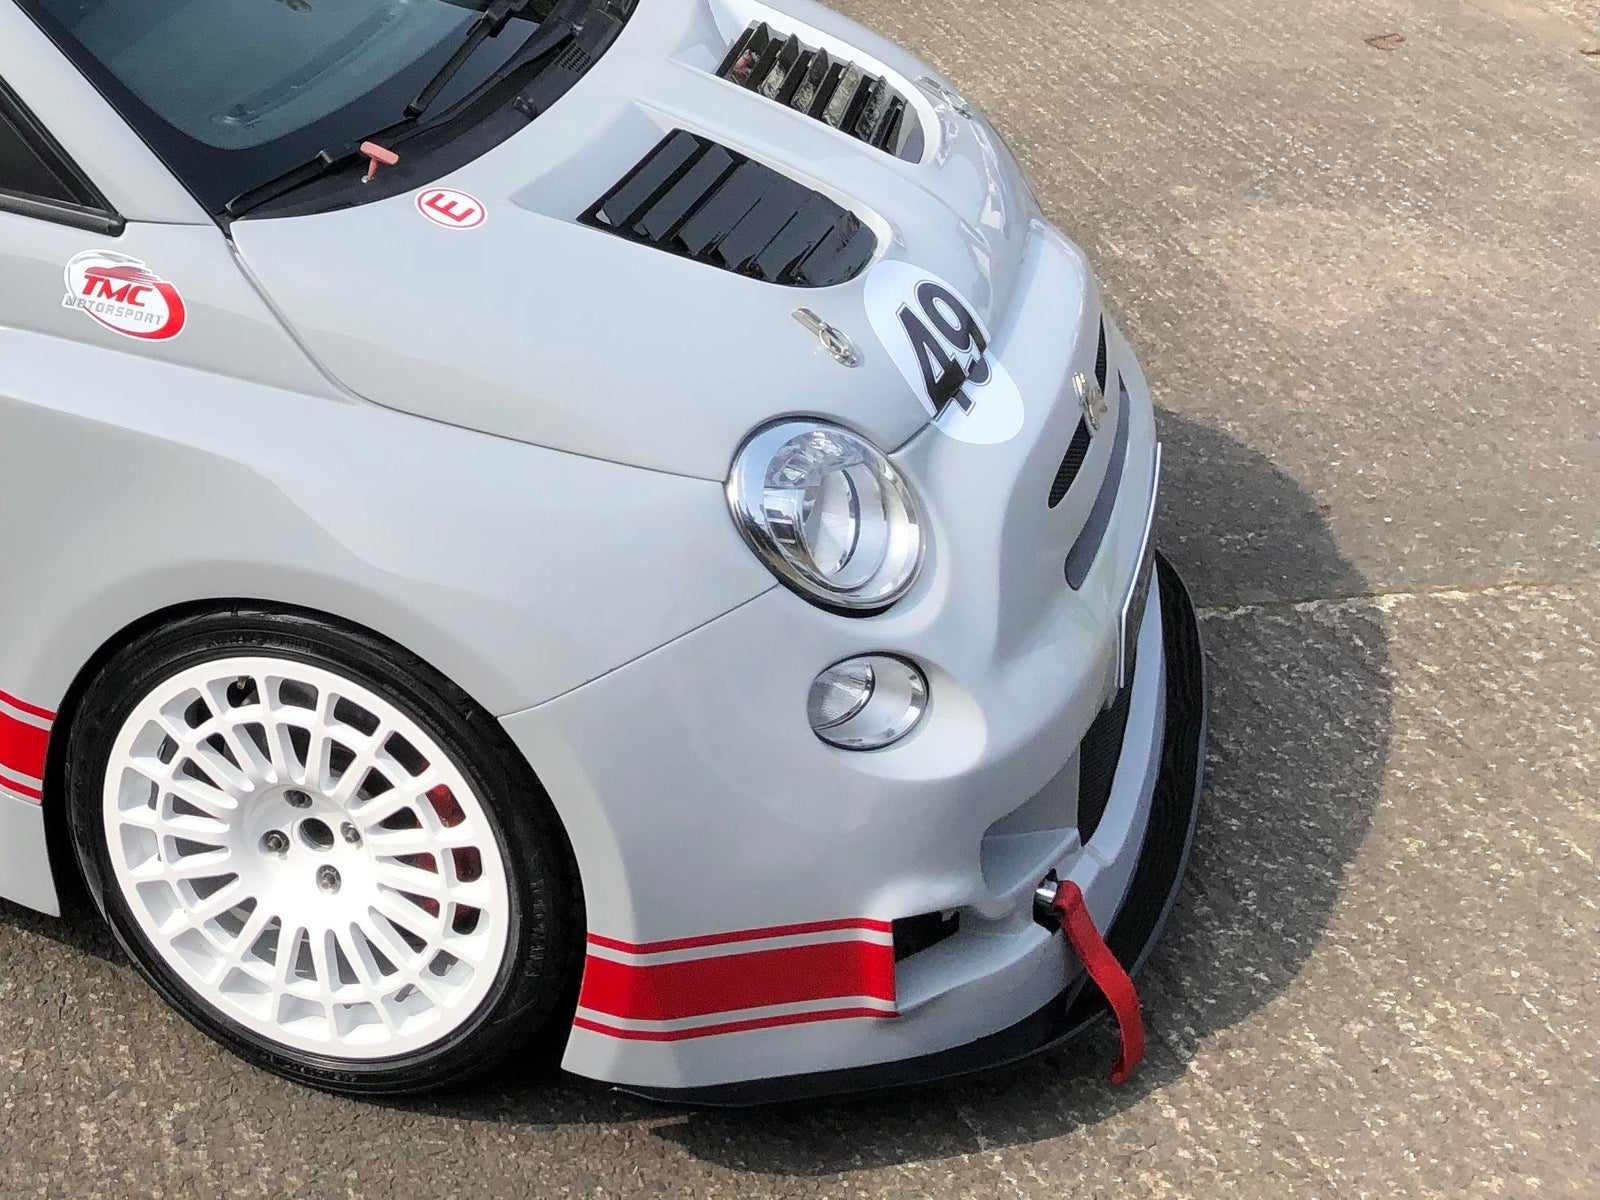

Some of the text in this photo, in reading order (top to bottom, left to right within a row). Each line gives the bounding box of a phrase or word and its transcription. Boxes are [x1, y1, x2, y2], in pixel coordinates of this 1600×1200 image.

[424, 192, 476, 223] E
[82, 274, 154, 307] TMC
[64, 294, 165, 326] MOTORSPORT
[895, 279, 992, 422] 49
